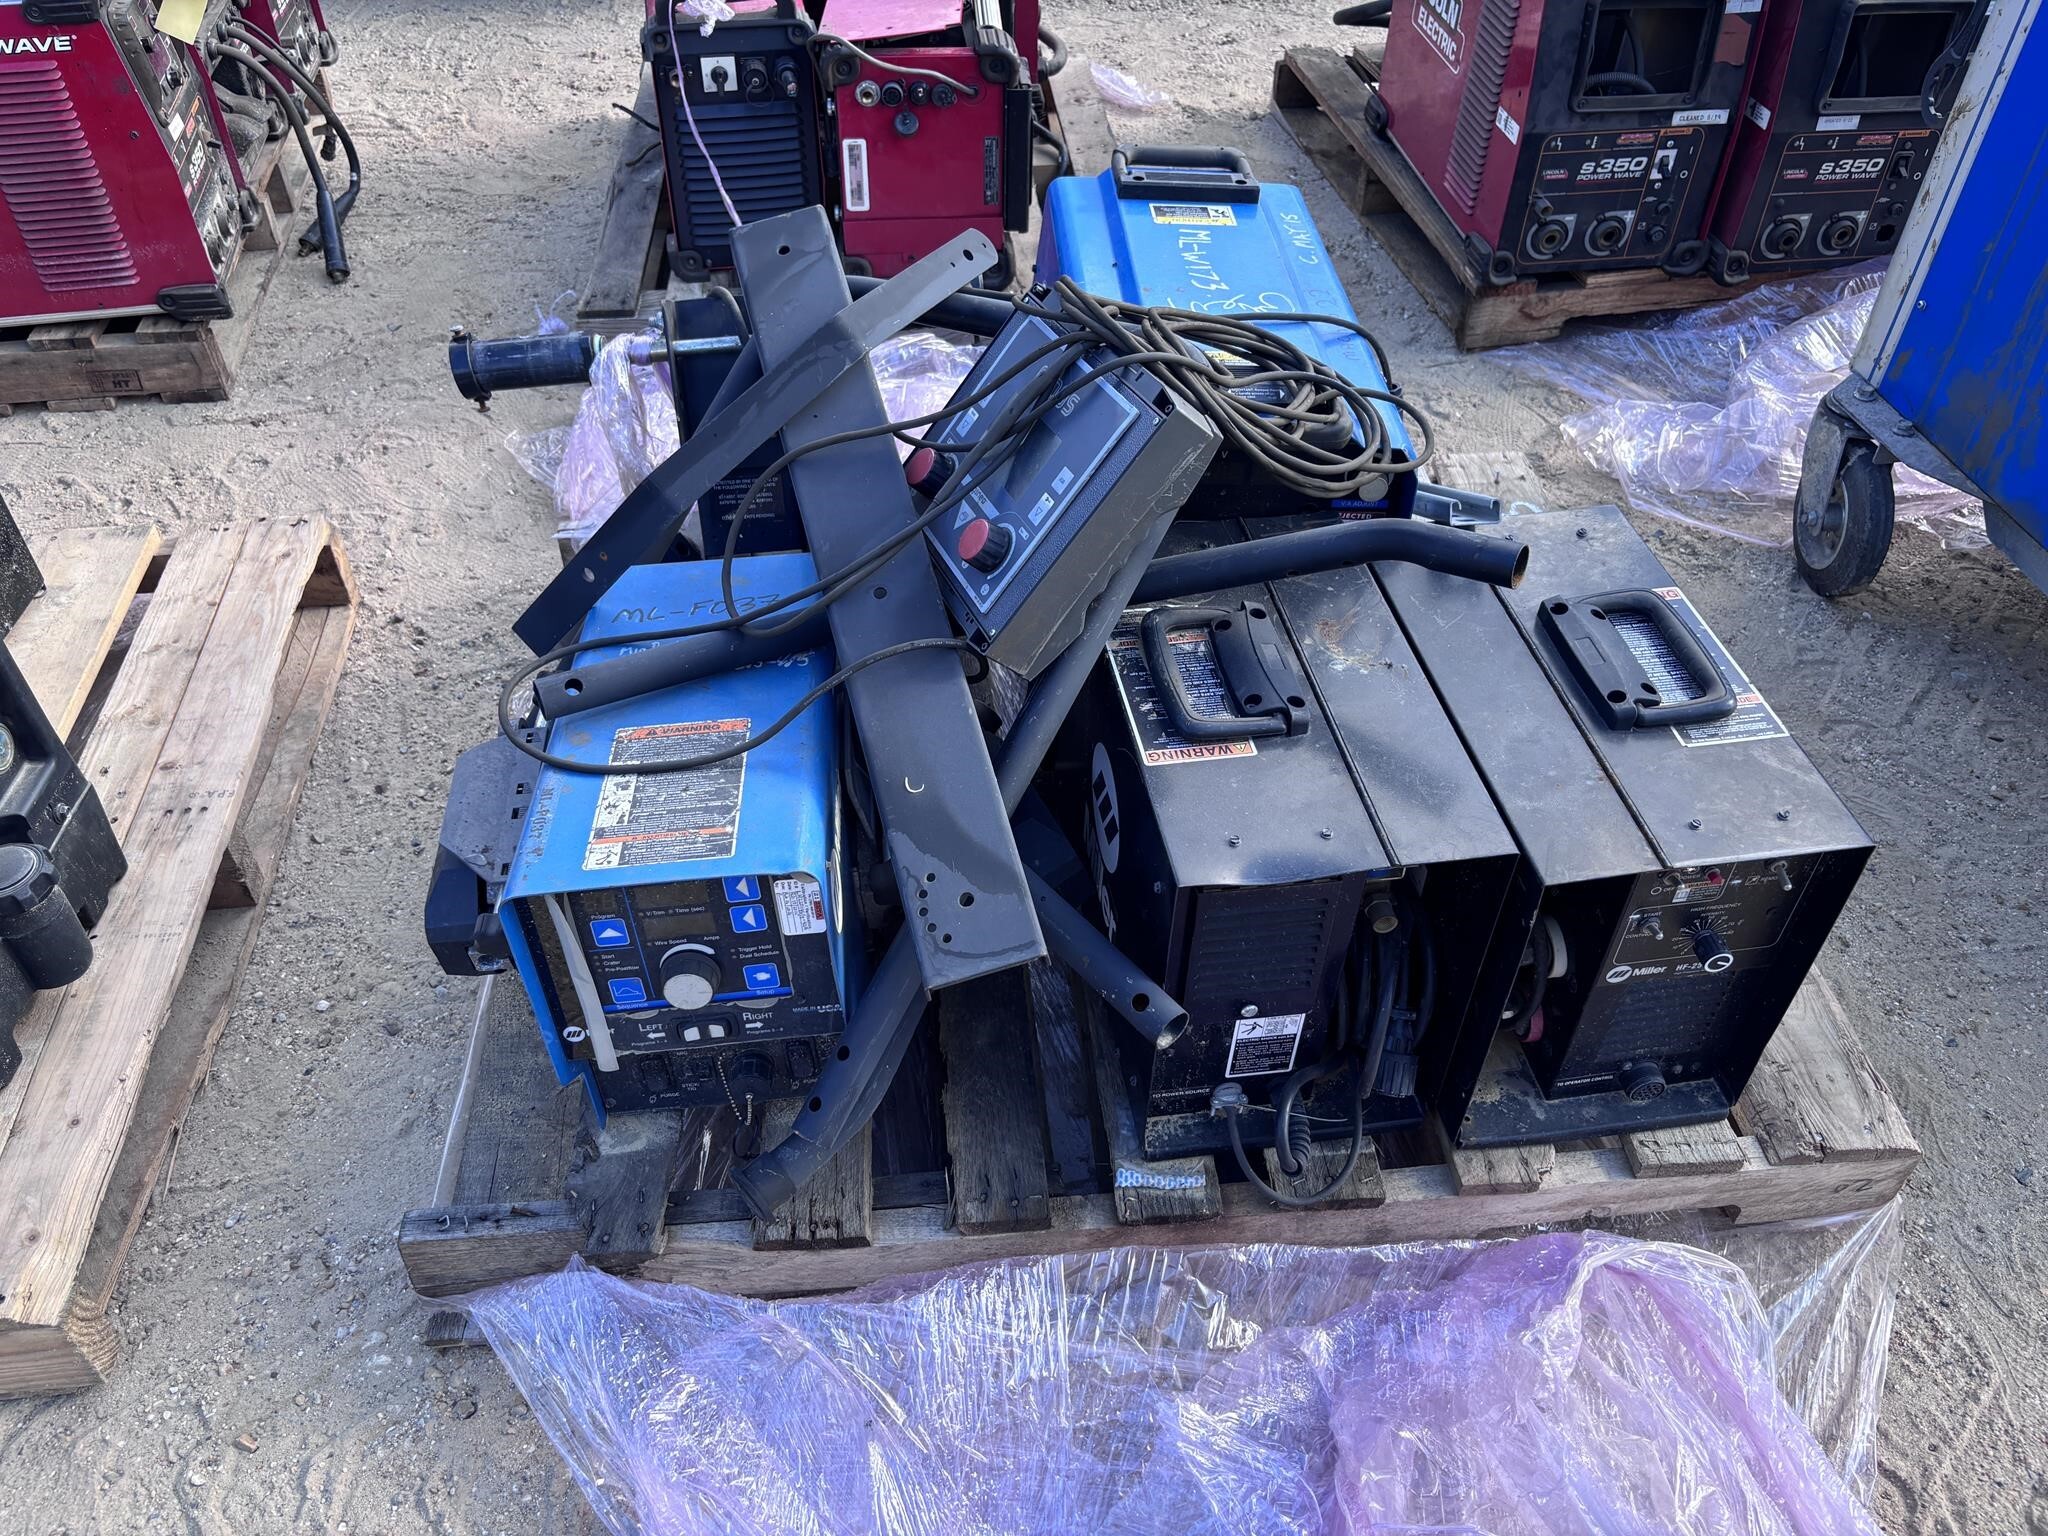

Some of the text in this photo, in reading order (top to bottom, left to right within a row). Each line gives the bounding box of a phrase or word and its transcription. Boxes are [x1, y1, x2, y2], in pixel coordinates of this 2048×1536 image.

[1418, 6, 1457, 61] ELECTRIC
[1678, 114, 1705, 122] CLEANED
[1580, 157, 1648, 174] S350
[1819, 158, 1885, 174] S350
[1576, 173, 1613, 181] POWER
[1614, 171, 1642, 179] WAVE
[1815, 173, 1849, 181] POWER
[662, 724, 721, 735] WARNING
[1148, 744, 1234, 762] WARNING
[738, 946, 757, 954] Trigger
[1632, 965, 1668, 977] Miller
[616, 1002, 649, 1010] Sequence
[1564, 1078, 1590, 1086] OPERATOR
